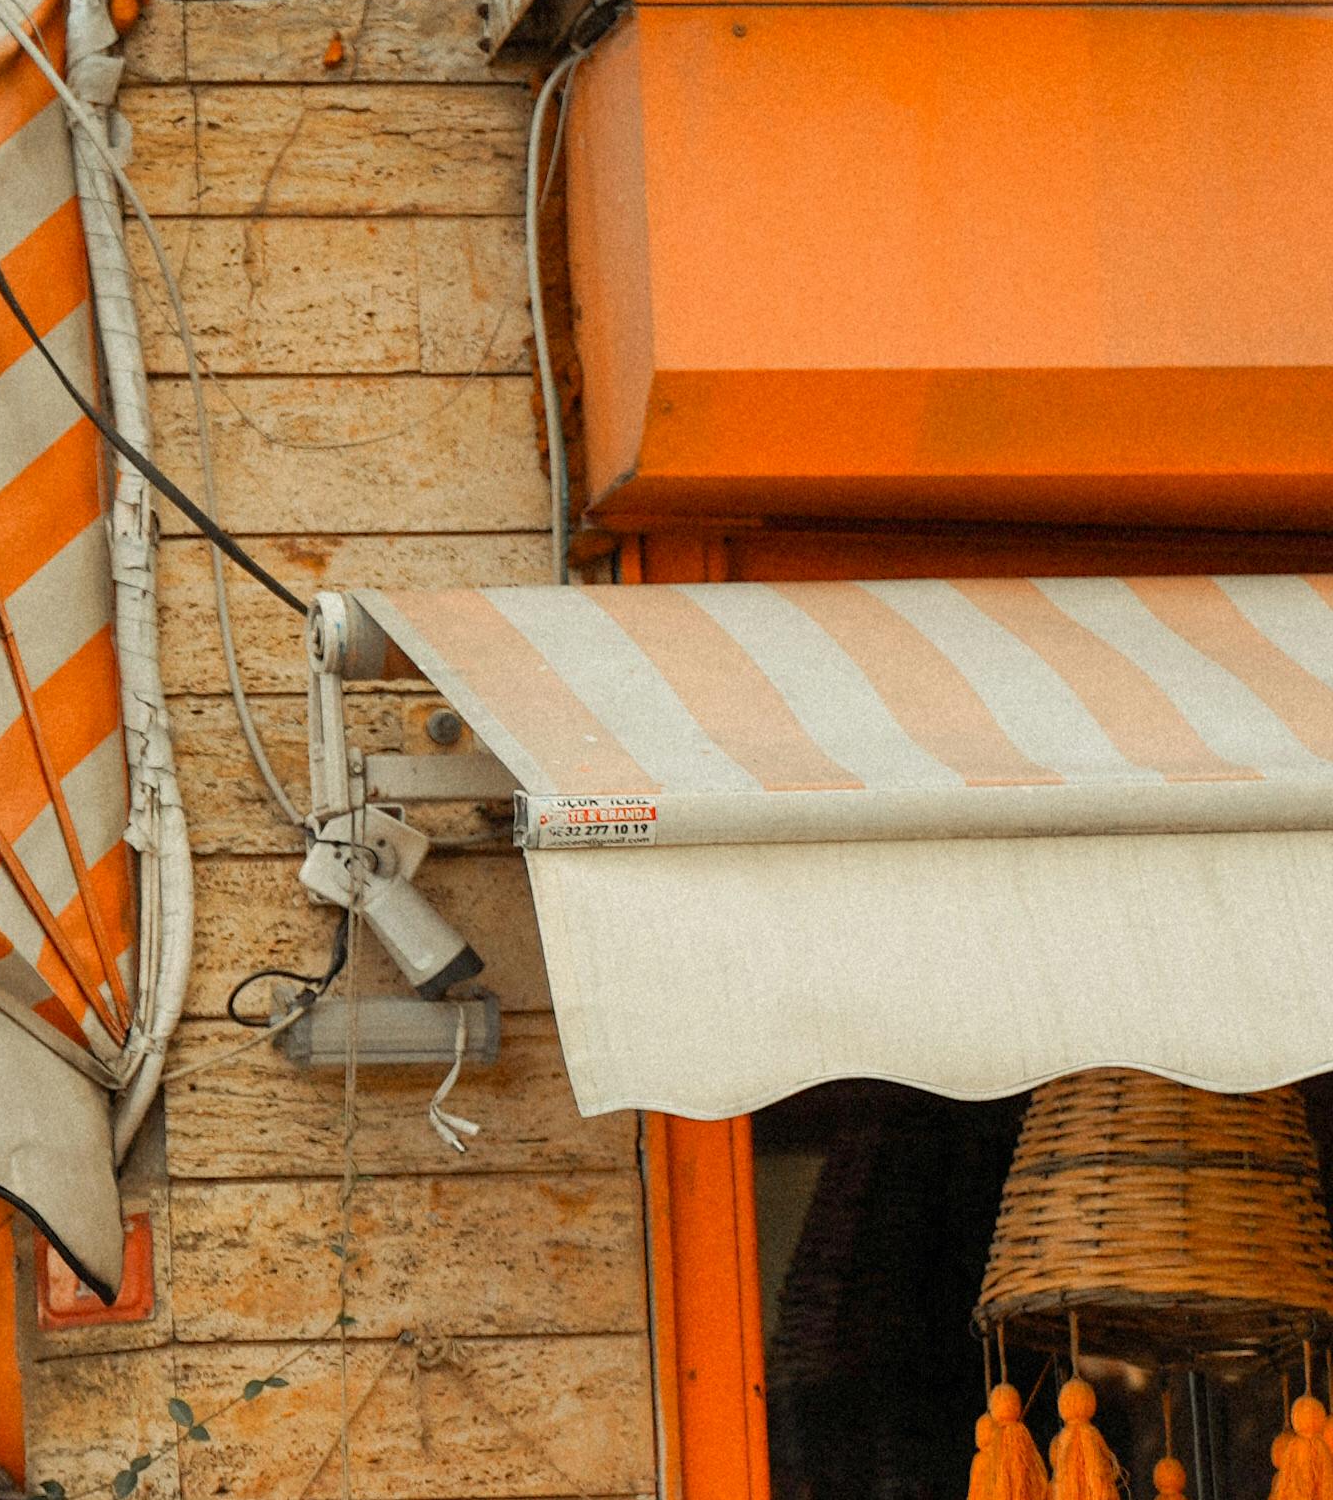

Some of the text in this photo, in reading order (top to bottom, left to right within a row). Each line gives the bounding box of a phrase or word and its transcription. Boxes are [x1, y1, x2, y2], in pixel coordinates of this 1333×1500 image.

[600, 807, 653, 822] BRANDA
[585, 825, 609, 837] 277
[614, 824, 629, 835] 10
